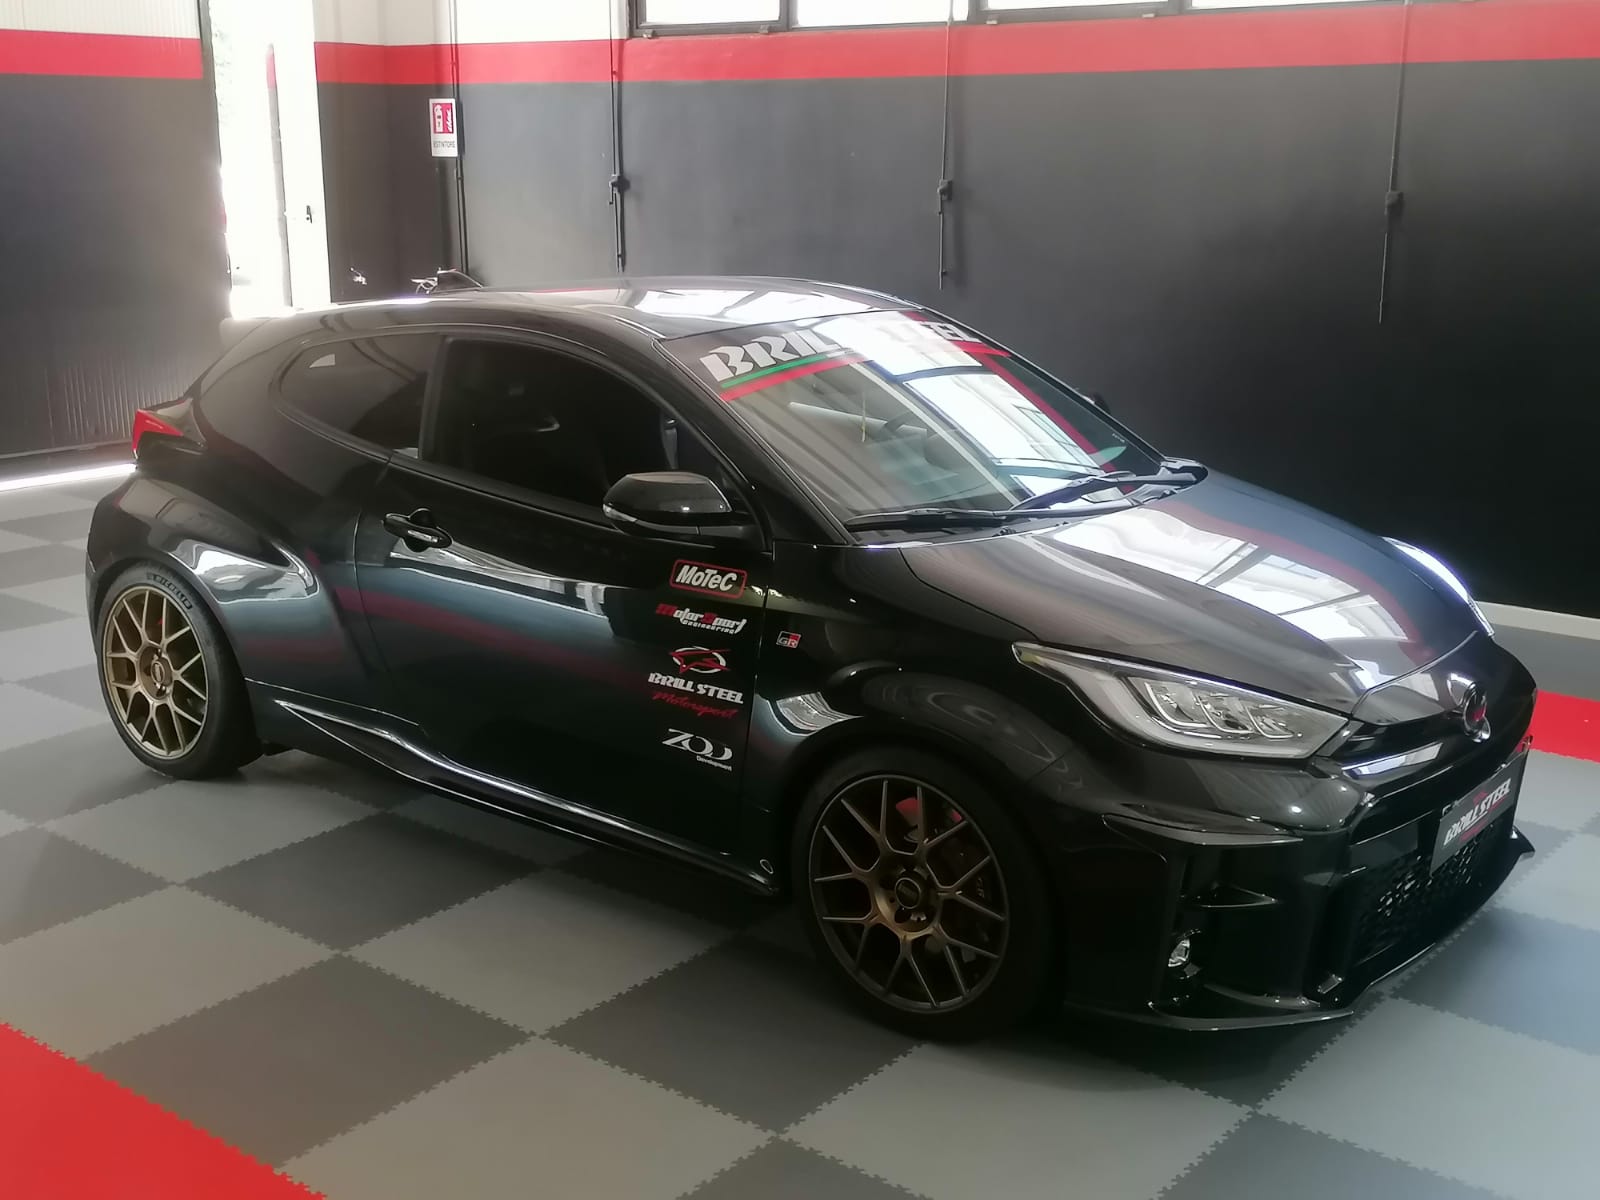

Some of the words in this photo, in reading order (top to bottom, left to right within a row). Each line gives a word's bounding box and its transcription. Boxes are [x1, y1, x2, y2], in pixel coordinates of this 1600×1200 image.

[675, 564, 738, 591] MoTeC
[778, 635, 799, 648] GR
[648, 672, 695, 693] BRILL
[696, 683, 744, 704] STEEL
[1443, 804, 1480, 846] BRILL
[1478, 778, 1511, 816] STEEL
